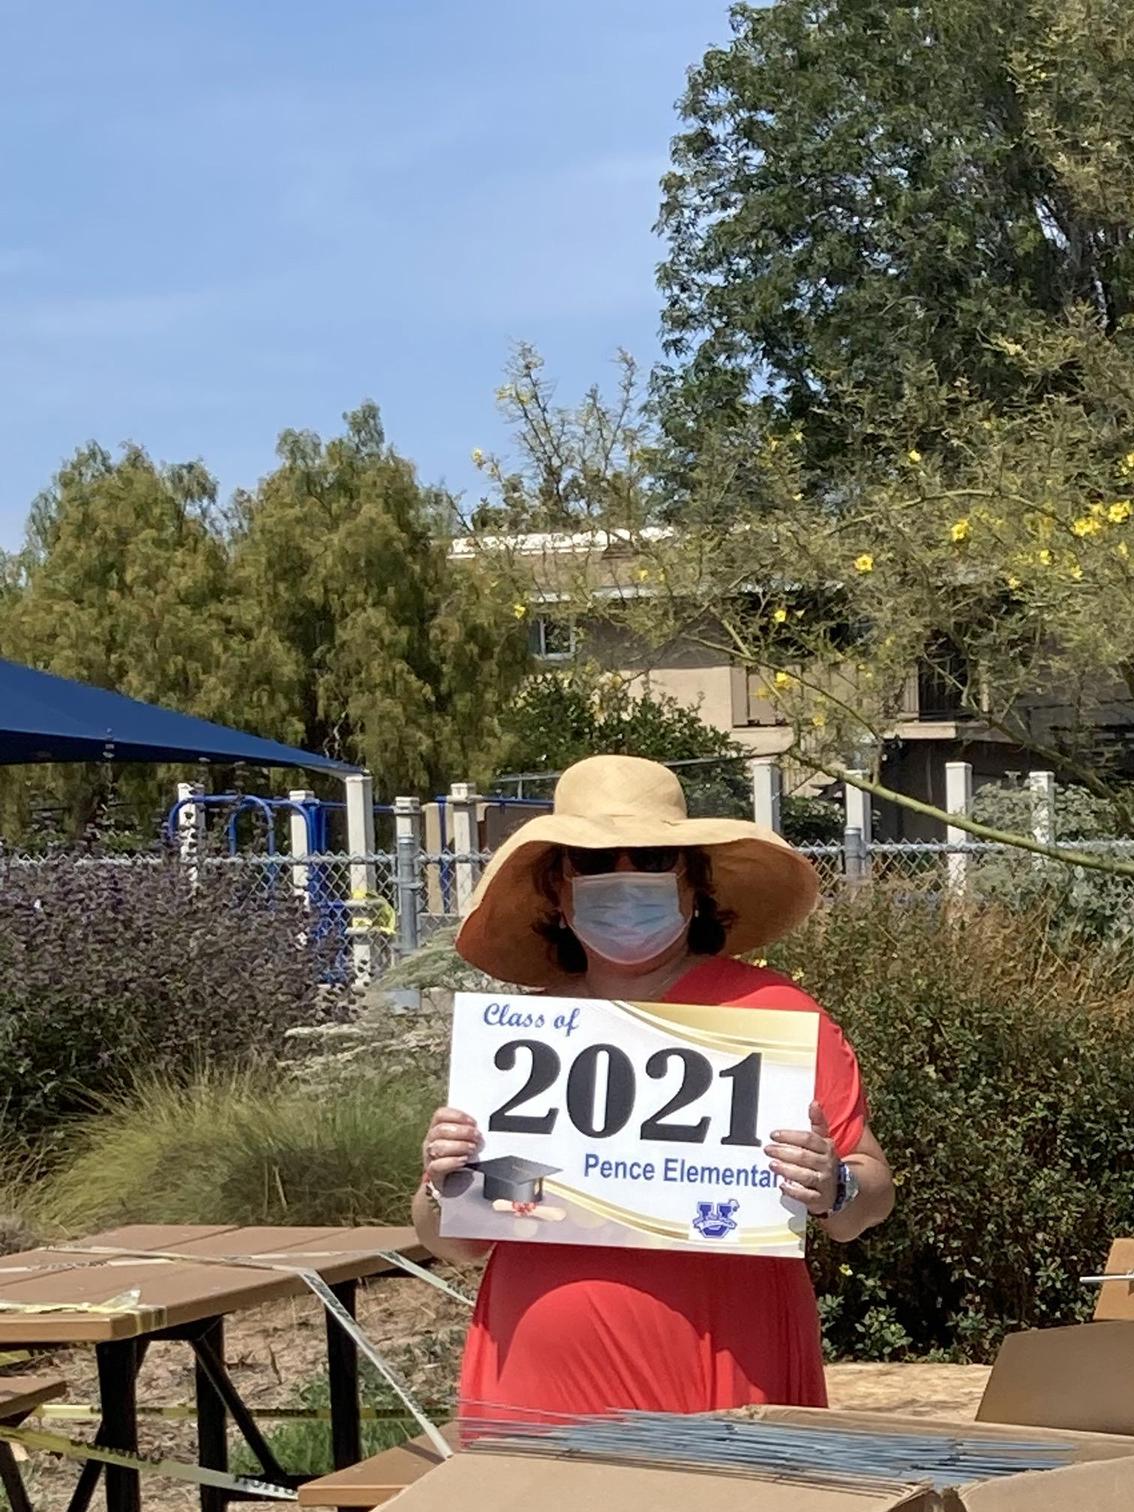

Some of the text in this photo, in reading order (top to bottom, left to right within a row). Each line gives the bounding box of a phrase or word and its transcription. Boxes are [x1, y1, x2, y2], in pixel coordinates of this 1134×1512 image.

[483, 1003, 581, 1037] Class of
[488, 1039, 762, 1147] 2021
[584, 1153, 778, 1189] Pence Elementar
